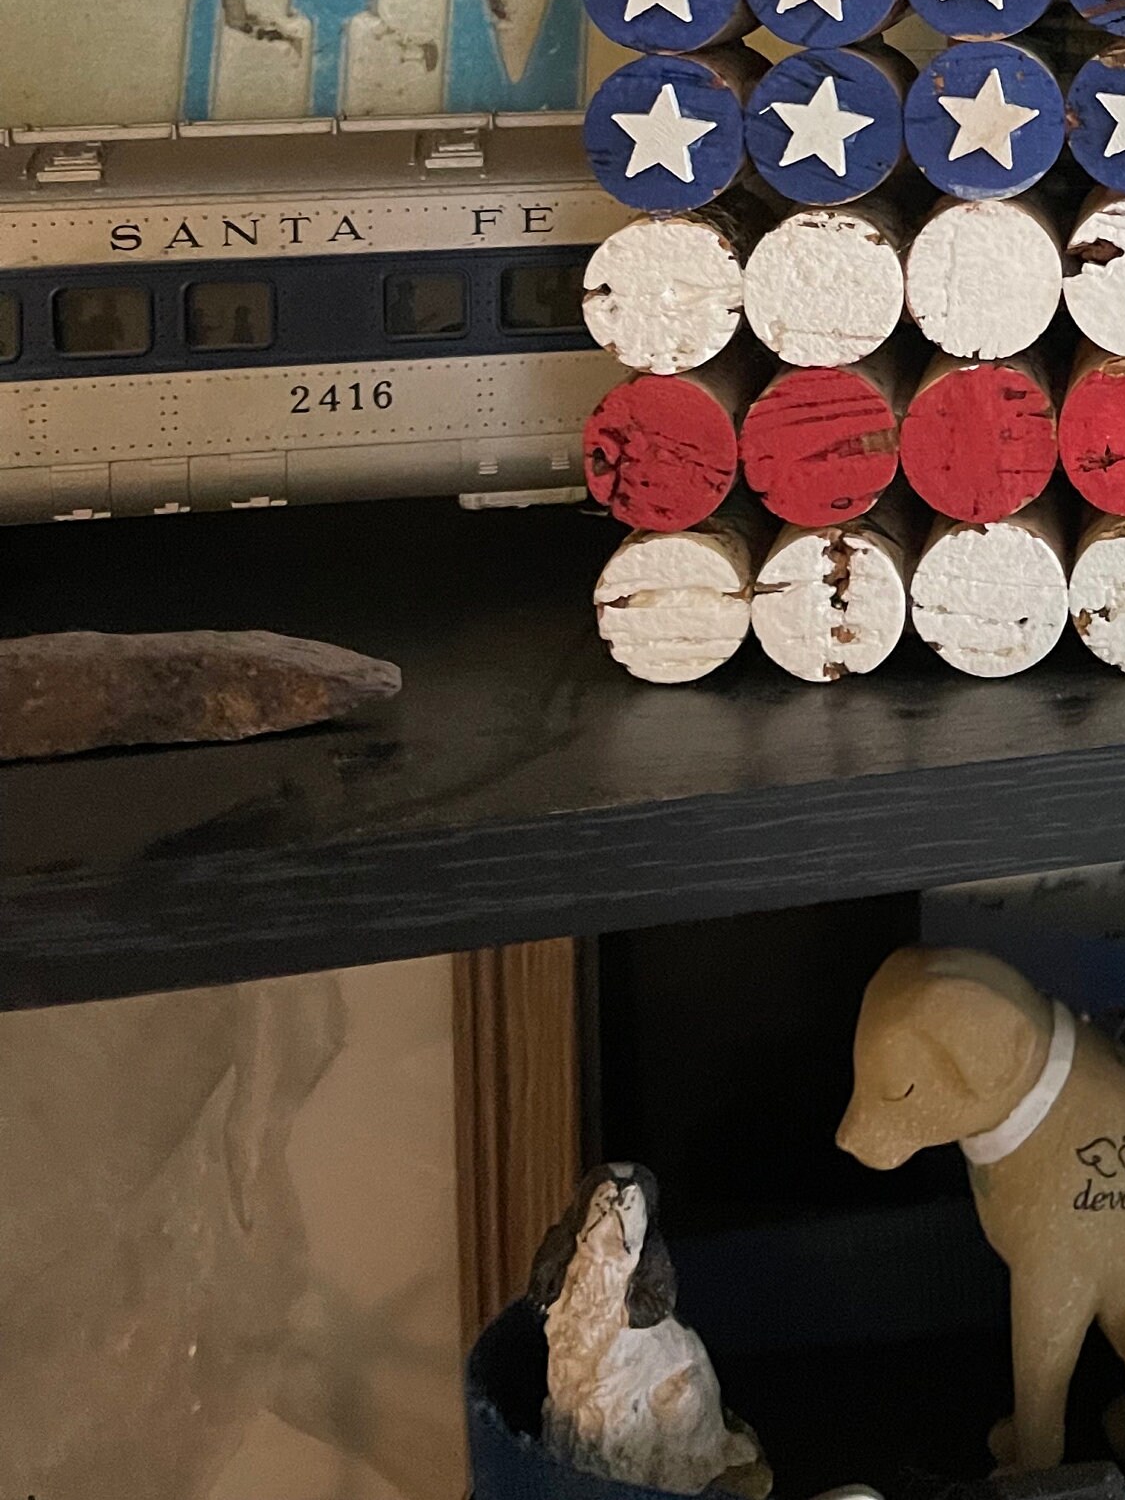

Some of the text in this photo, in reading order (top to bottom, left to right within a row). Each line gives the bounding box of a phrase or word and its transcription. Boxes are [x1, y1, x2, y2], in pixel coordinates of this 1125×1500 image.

[110, 206, 555, 252] SANTA FE
[290, 380, 394, 414] 2416
